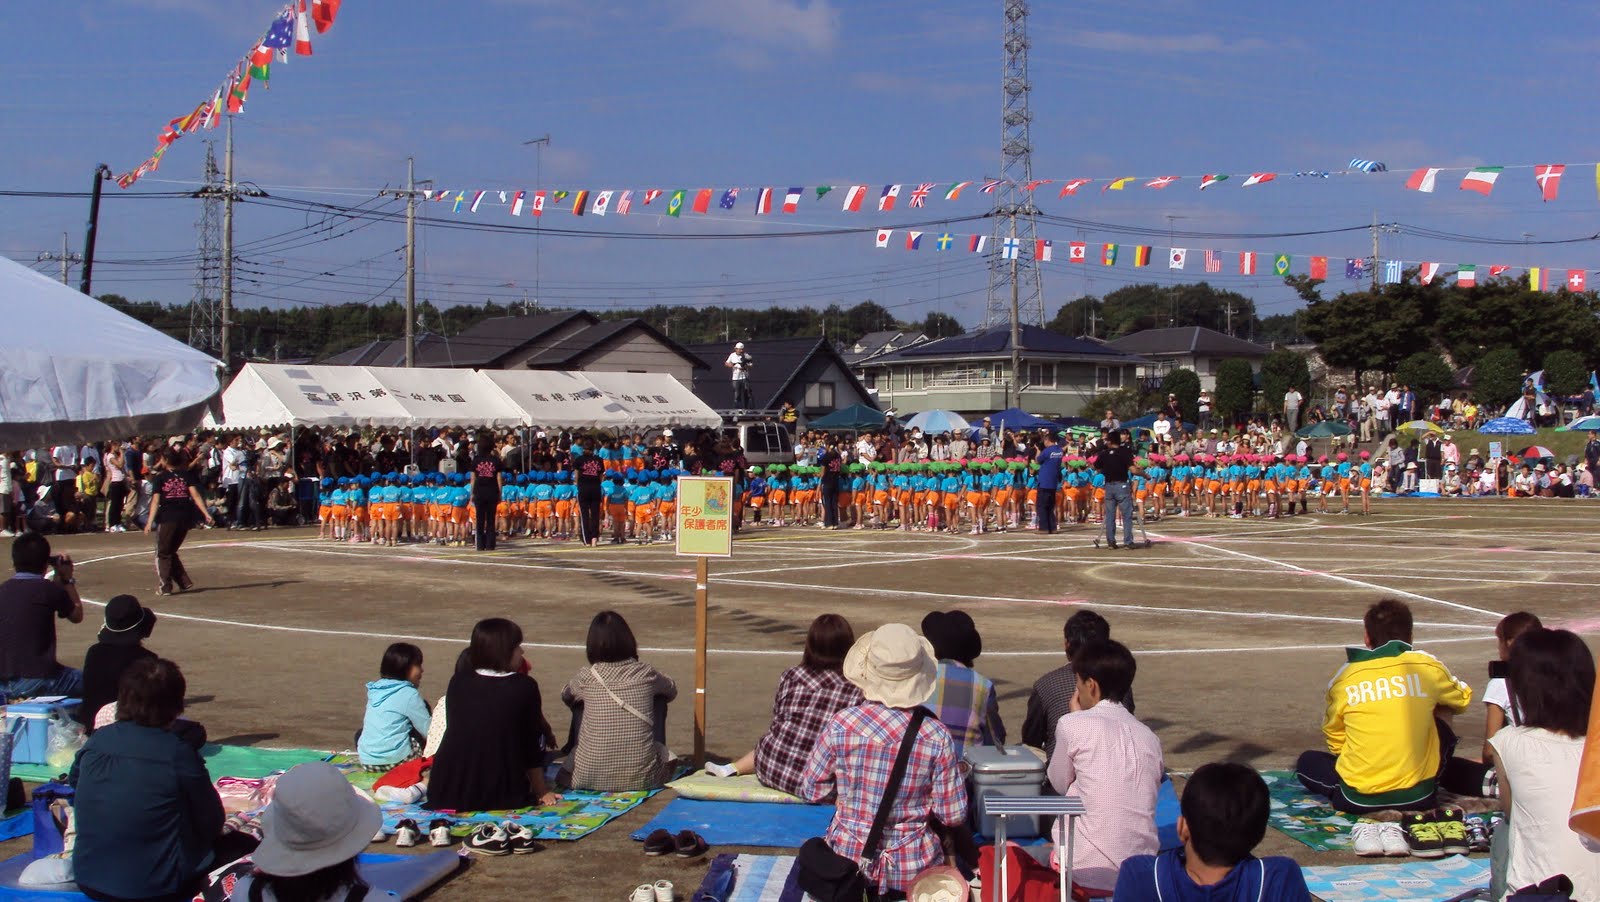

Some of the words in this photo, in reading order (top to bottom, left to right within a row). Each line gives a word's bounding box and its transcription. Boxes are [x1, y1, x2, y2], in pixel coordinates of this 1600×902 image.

[680, 505, 703, 517] 年少
[683, 519, 728, 531] 保護者席
[1345, 673, 1428, 707] BRASIL
